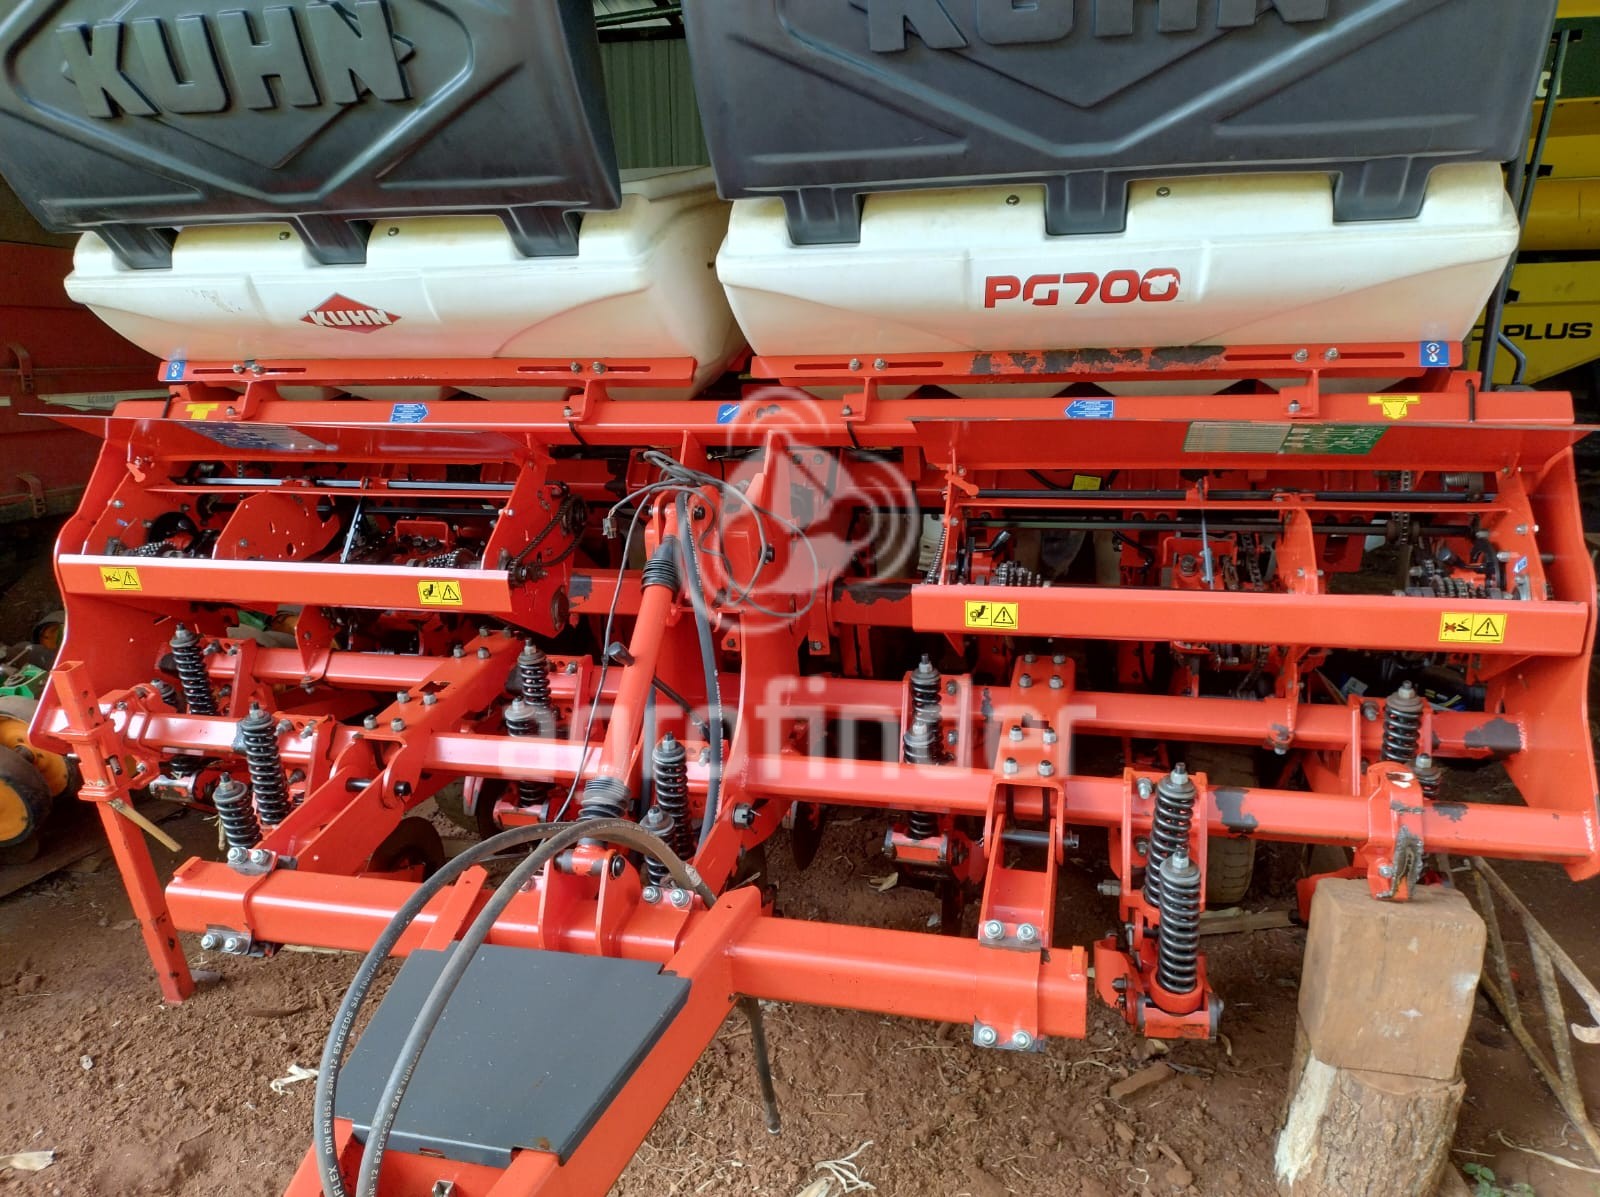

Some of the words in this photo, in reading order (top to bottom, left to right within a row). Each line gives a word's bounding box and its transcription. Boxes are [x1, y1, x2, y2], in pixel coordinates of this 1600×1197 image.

[57, 0, 413, 119] KUHN
[984, 267, 1181, 308] PG700
[306, 307, 397, 328] KUHN
[1503, 321, 1594, 341] PLUS
[350, 991, 363, 1008] SAE
[332, 1010, 354, 1055] EXCEEDS
[391, 1087, 405, 1109] SAE
[323, 1119, 333, 1134] EN
[324, 1136, 334, 1155] DIN
